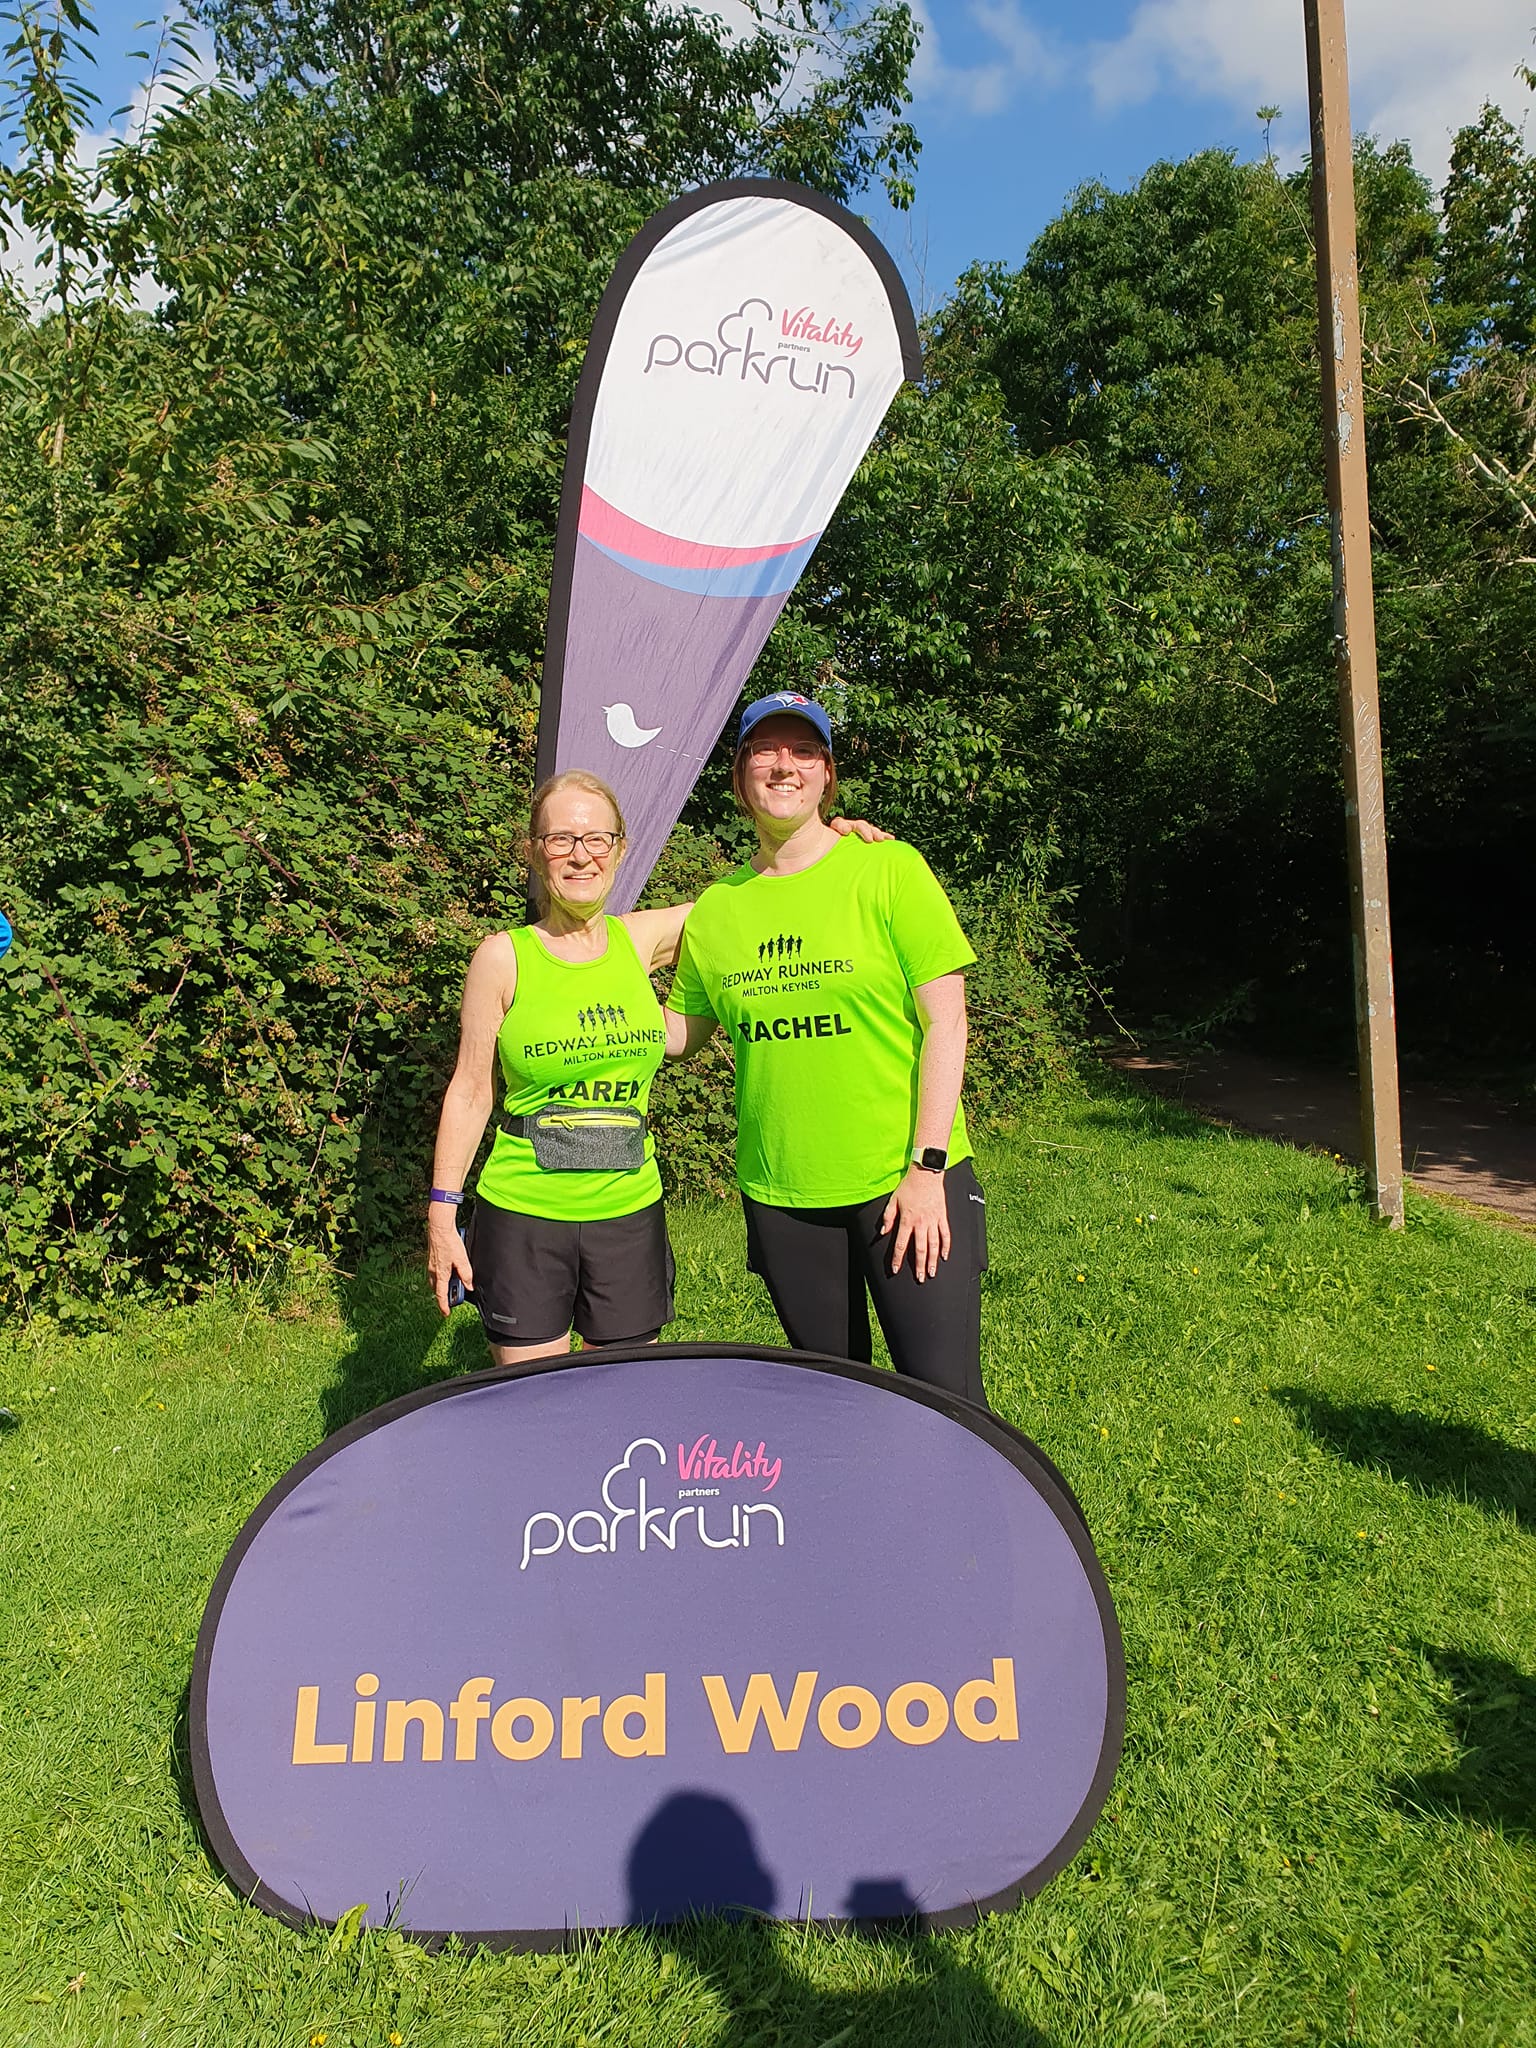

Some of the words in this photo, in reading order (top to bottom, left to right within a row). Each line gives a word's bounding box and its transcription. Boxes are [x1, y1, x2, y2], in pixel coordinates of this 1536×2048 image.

[777, 341, 811, 353] partners
[781, 306, 864, 358] Vitality
[643, 297, 856, 399] parkrun
[721, 966, 773, 990] REDWAY
[778, 959, 854, 979] RUNNERS
[742, 985, 778, 998] MILTON
[782, 980, 820, 992] KEYNES
[737, 1013, 852, 1043] RACHEL
[523, 1035, 598, 1059] REDWAY
[563, 1051, 604, 1066] MILTON
[608, 1047, 648, 1058] KEYNES
[677, 1433, 783, 1492] Vitality
[519, 1437, 785, 1571] parkrun
[678, 1487, 720, 1499] partners
[292, 1673, 667, 1765] Linford
[702, 1657, 1020, 1754] Wood
